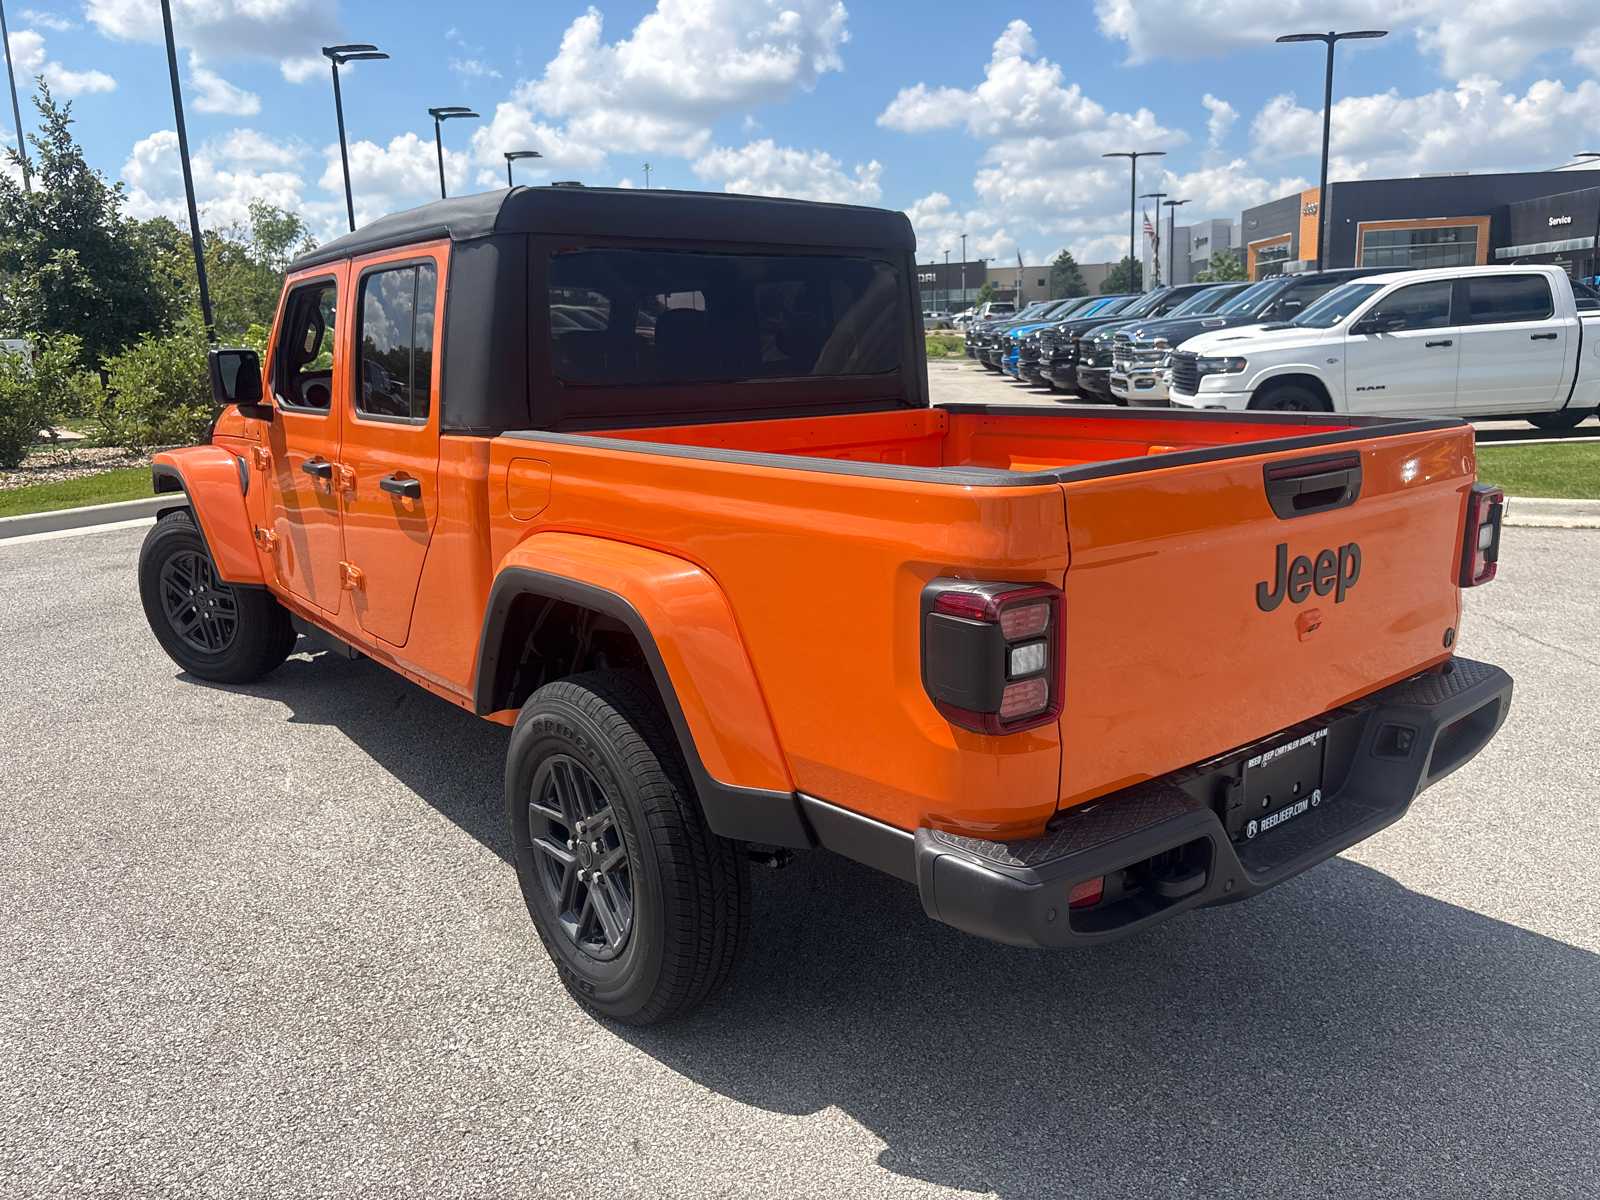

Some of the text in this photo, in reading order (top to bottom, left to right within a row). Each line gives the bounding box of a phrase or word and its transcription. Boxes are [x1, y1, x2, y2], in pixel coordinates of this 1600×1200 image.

[1548, 214, 1572, 226] Service
[1256, 542, 1362, 612] Jeep
[1247, 727, 1328, 768] REED JEEP CHRYSLER DODGE RAM
[1260, 798, 1309, 832] REEDJEEP.COM
